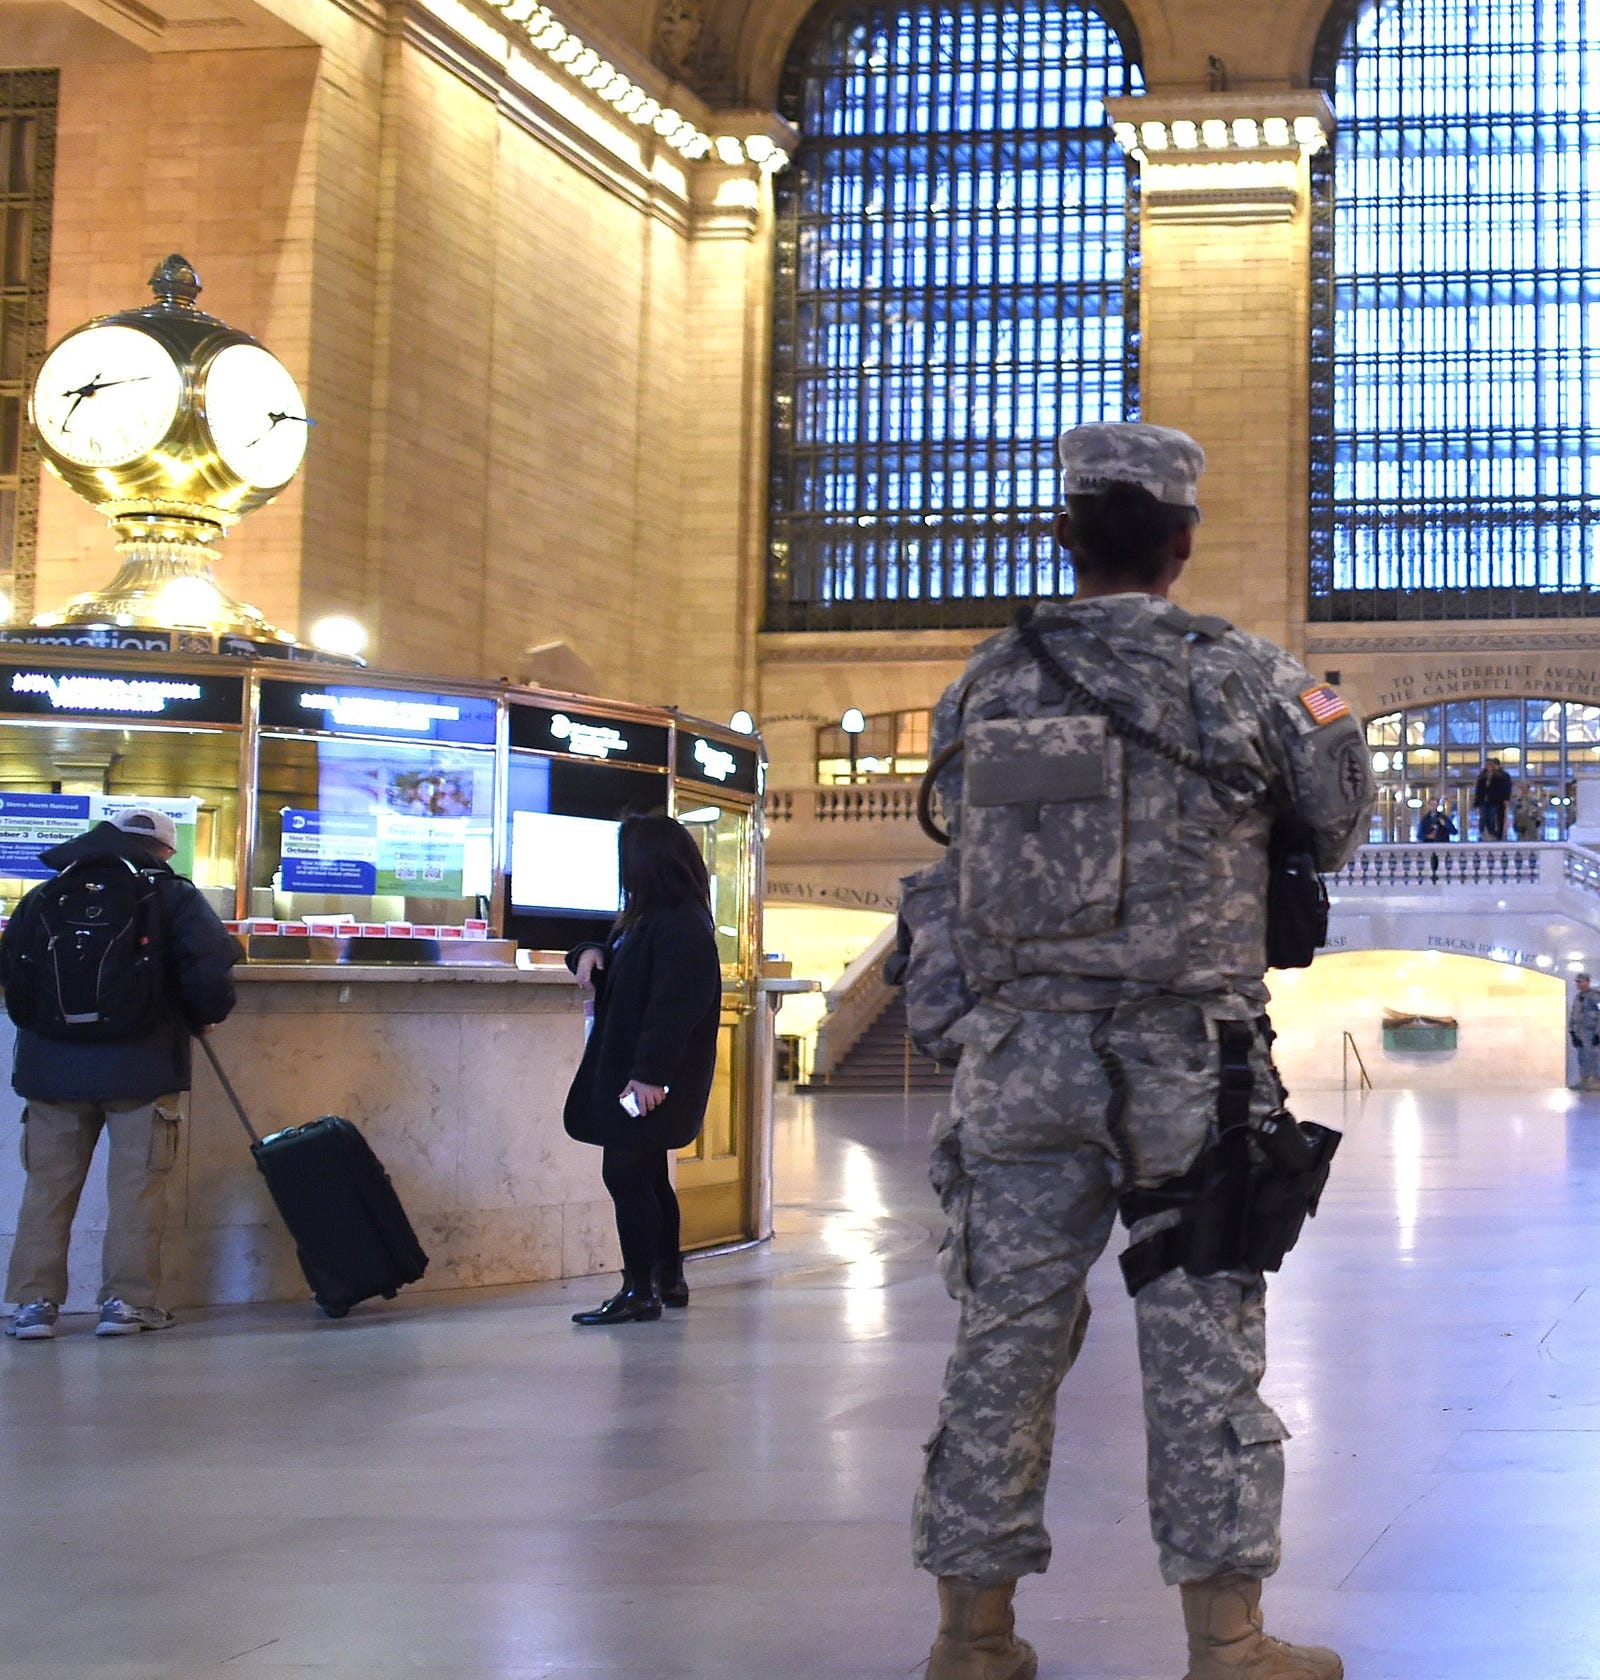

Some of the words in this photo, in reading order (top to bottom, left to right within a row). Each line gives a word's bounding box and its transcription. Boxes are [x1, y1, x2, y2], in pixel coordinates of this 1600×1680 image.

[0, 631, 168, 651] fmation
[1392, 675, 1414, 689] TO
[1424, 664, 1532, 682] VANDERBILT
[1378, 690, 1415, 706] THE
[1422, 679, 1513, 696] CAMPBELL
[1427, 935, 1476, 950] TRACKS
